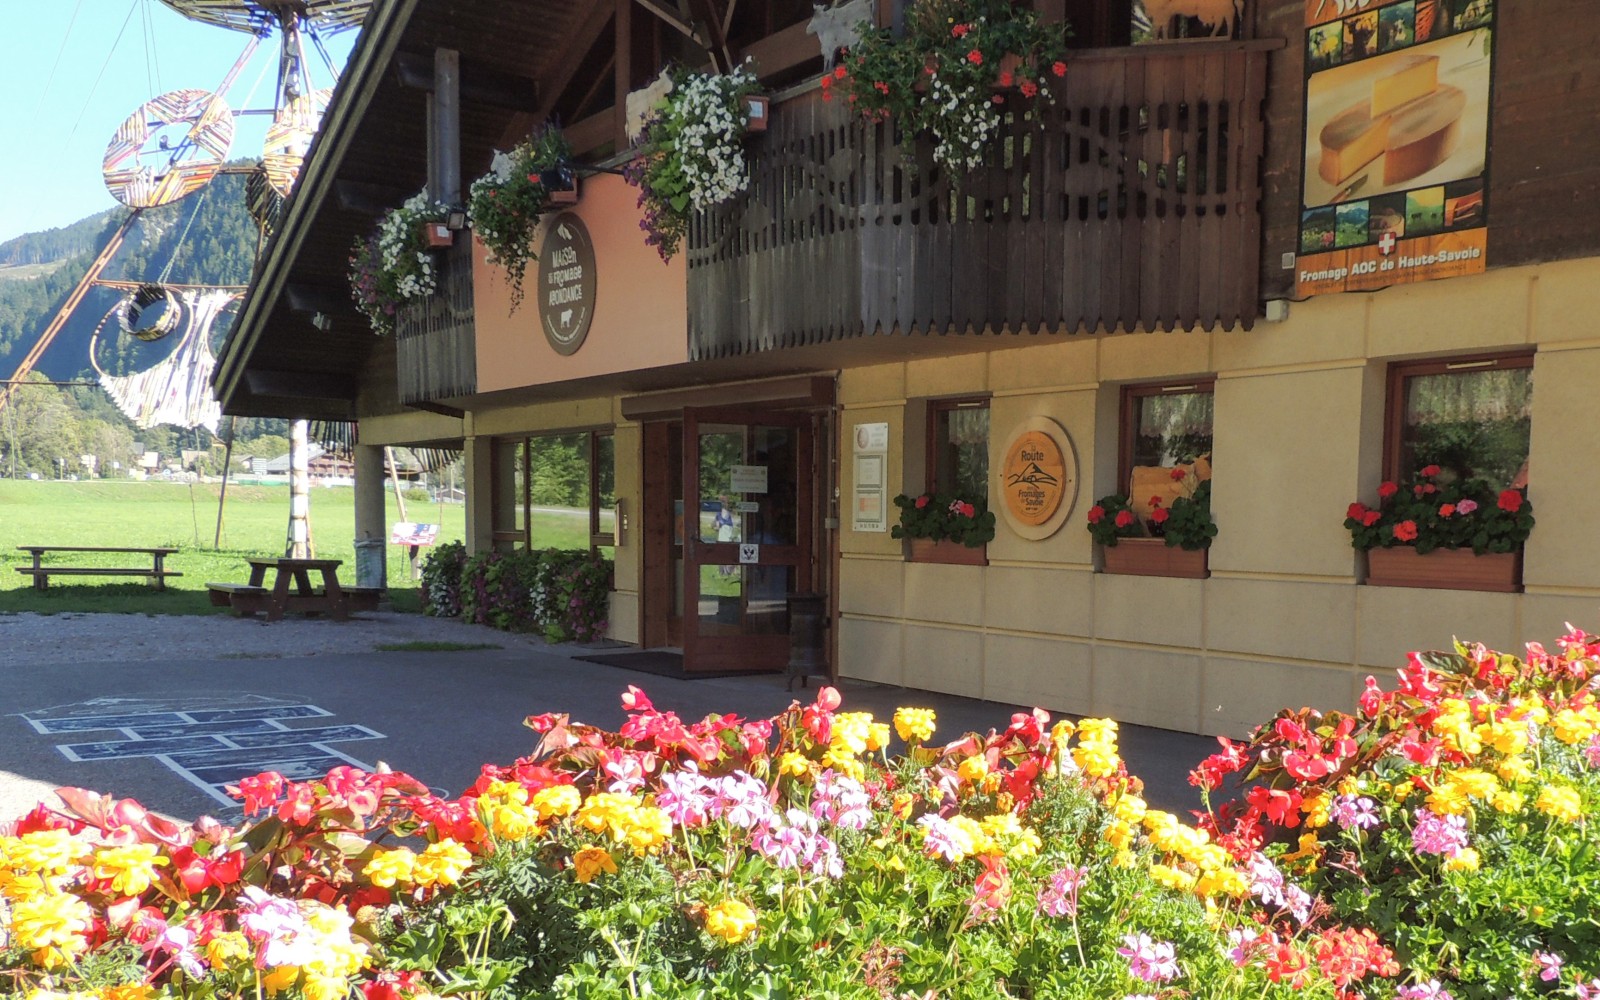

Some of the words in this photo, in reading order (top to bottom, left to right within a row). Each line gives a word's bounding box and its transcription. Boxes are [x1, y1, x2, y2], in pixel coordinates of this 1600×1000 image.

[1300, 267, 1348, 282] Fromage
[1351, 260, 1376, 276] AOC
[1380, 259, 1395, 271] de
[1398, 246, 1480, 268] Haute-Savoie
[549, 285, 582, 306] ABONDANCE
[1021, 450, 1044, 462] Route
